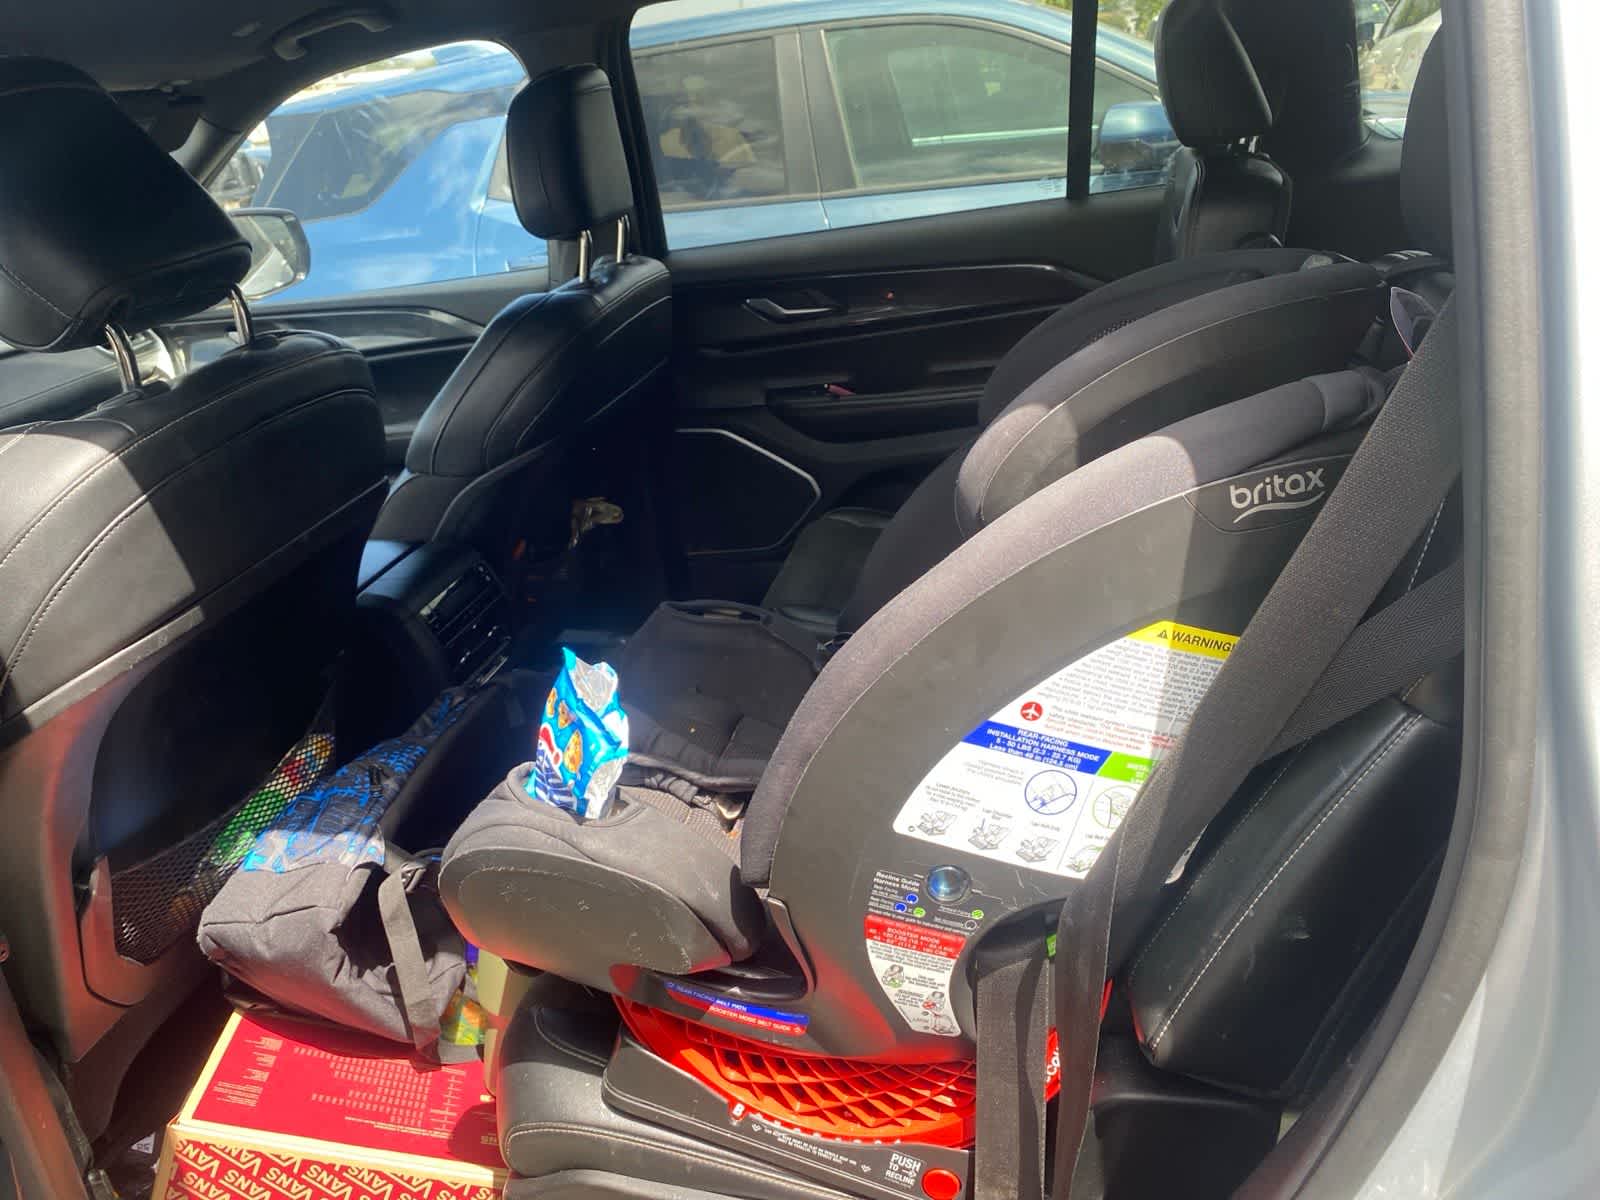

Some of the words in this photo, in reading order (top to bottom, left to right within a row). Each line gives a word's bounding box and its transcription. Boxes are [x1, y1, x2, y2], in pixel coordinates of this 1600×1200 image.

[1230, 468, 1325, 509] britax
[987, 728, 1039, 747] INSTALLATION
[1041, 742, 1076, 755] HARNESS
[1077, 751, 1100, 762] MODE
[1017, 729, 1068, 747] REAR-FACING
[1017, 743, 1032, 751] LBS
[732, 1103, 745, 1116] B
[889, 1162, 899, 1171] TO
[891, 1153, 921, 1172] PUSH
[219, 1169, 272, 1200] VANS
[260, 1167, 313, 1200] VANS
[302, 1164, 353, 1200] VANS
[343, 1165, 393, 1200] VANS
[885, 1169, 916, 1186] RECLINE
